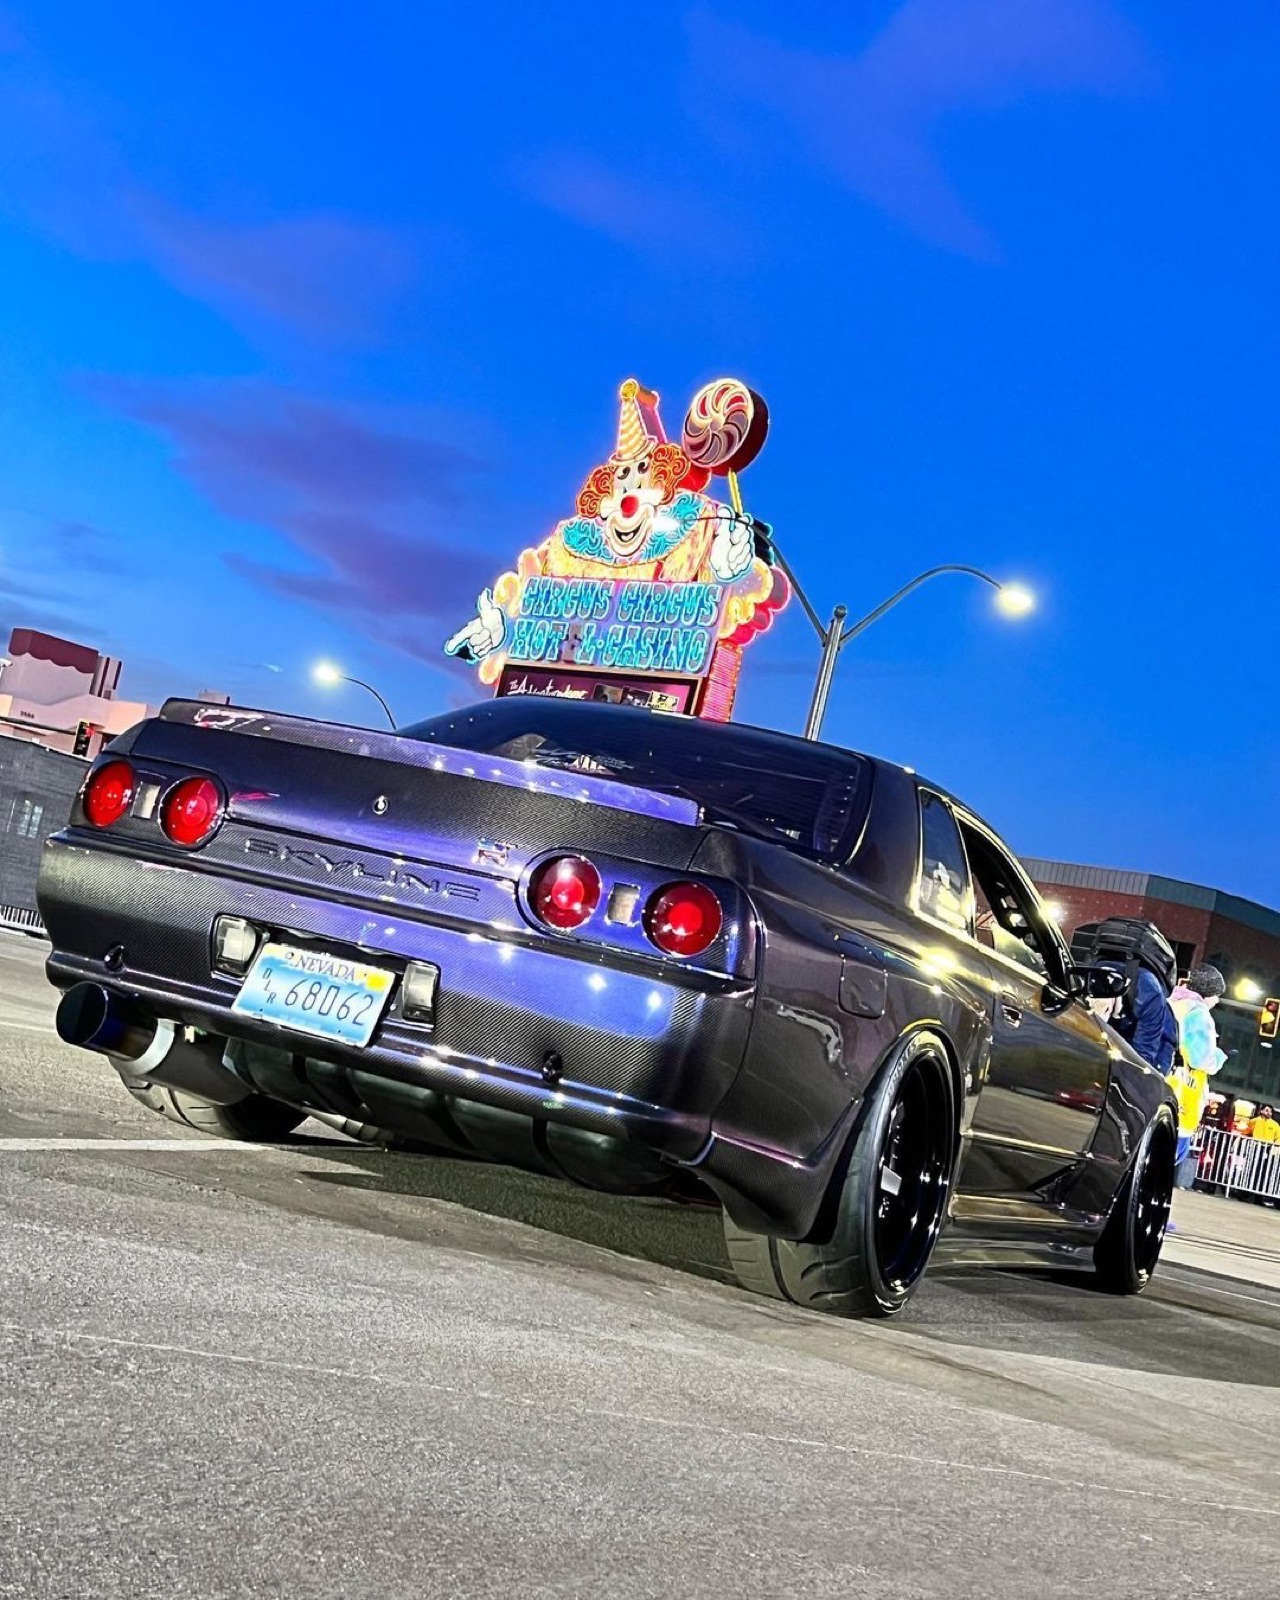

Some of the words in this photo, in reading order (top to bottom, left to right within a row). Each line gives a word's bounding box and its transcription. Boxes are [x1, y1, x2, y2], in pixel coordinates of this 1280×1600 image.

[519, 576, 615, 620] CIRCUS
[617, 580, 723, 627] CIRCUS
[601, 624, 710, 674] CASINO
[244, 836, 481, 902] SKYLINE
[295, 955, 356, 982] NEVADA
